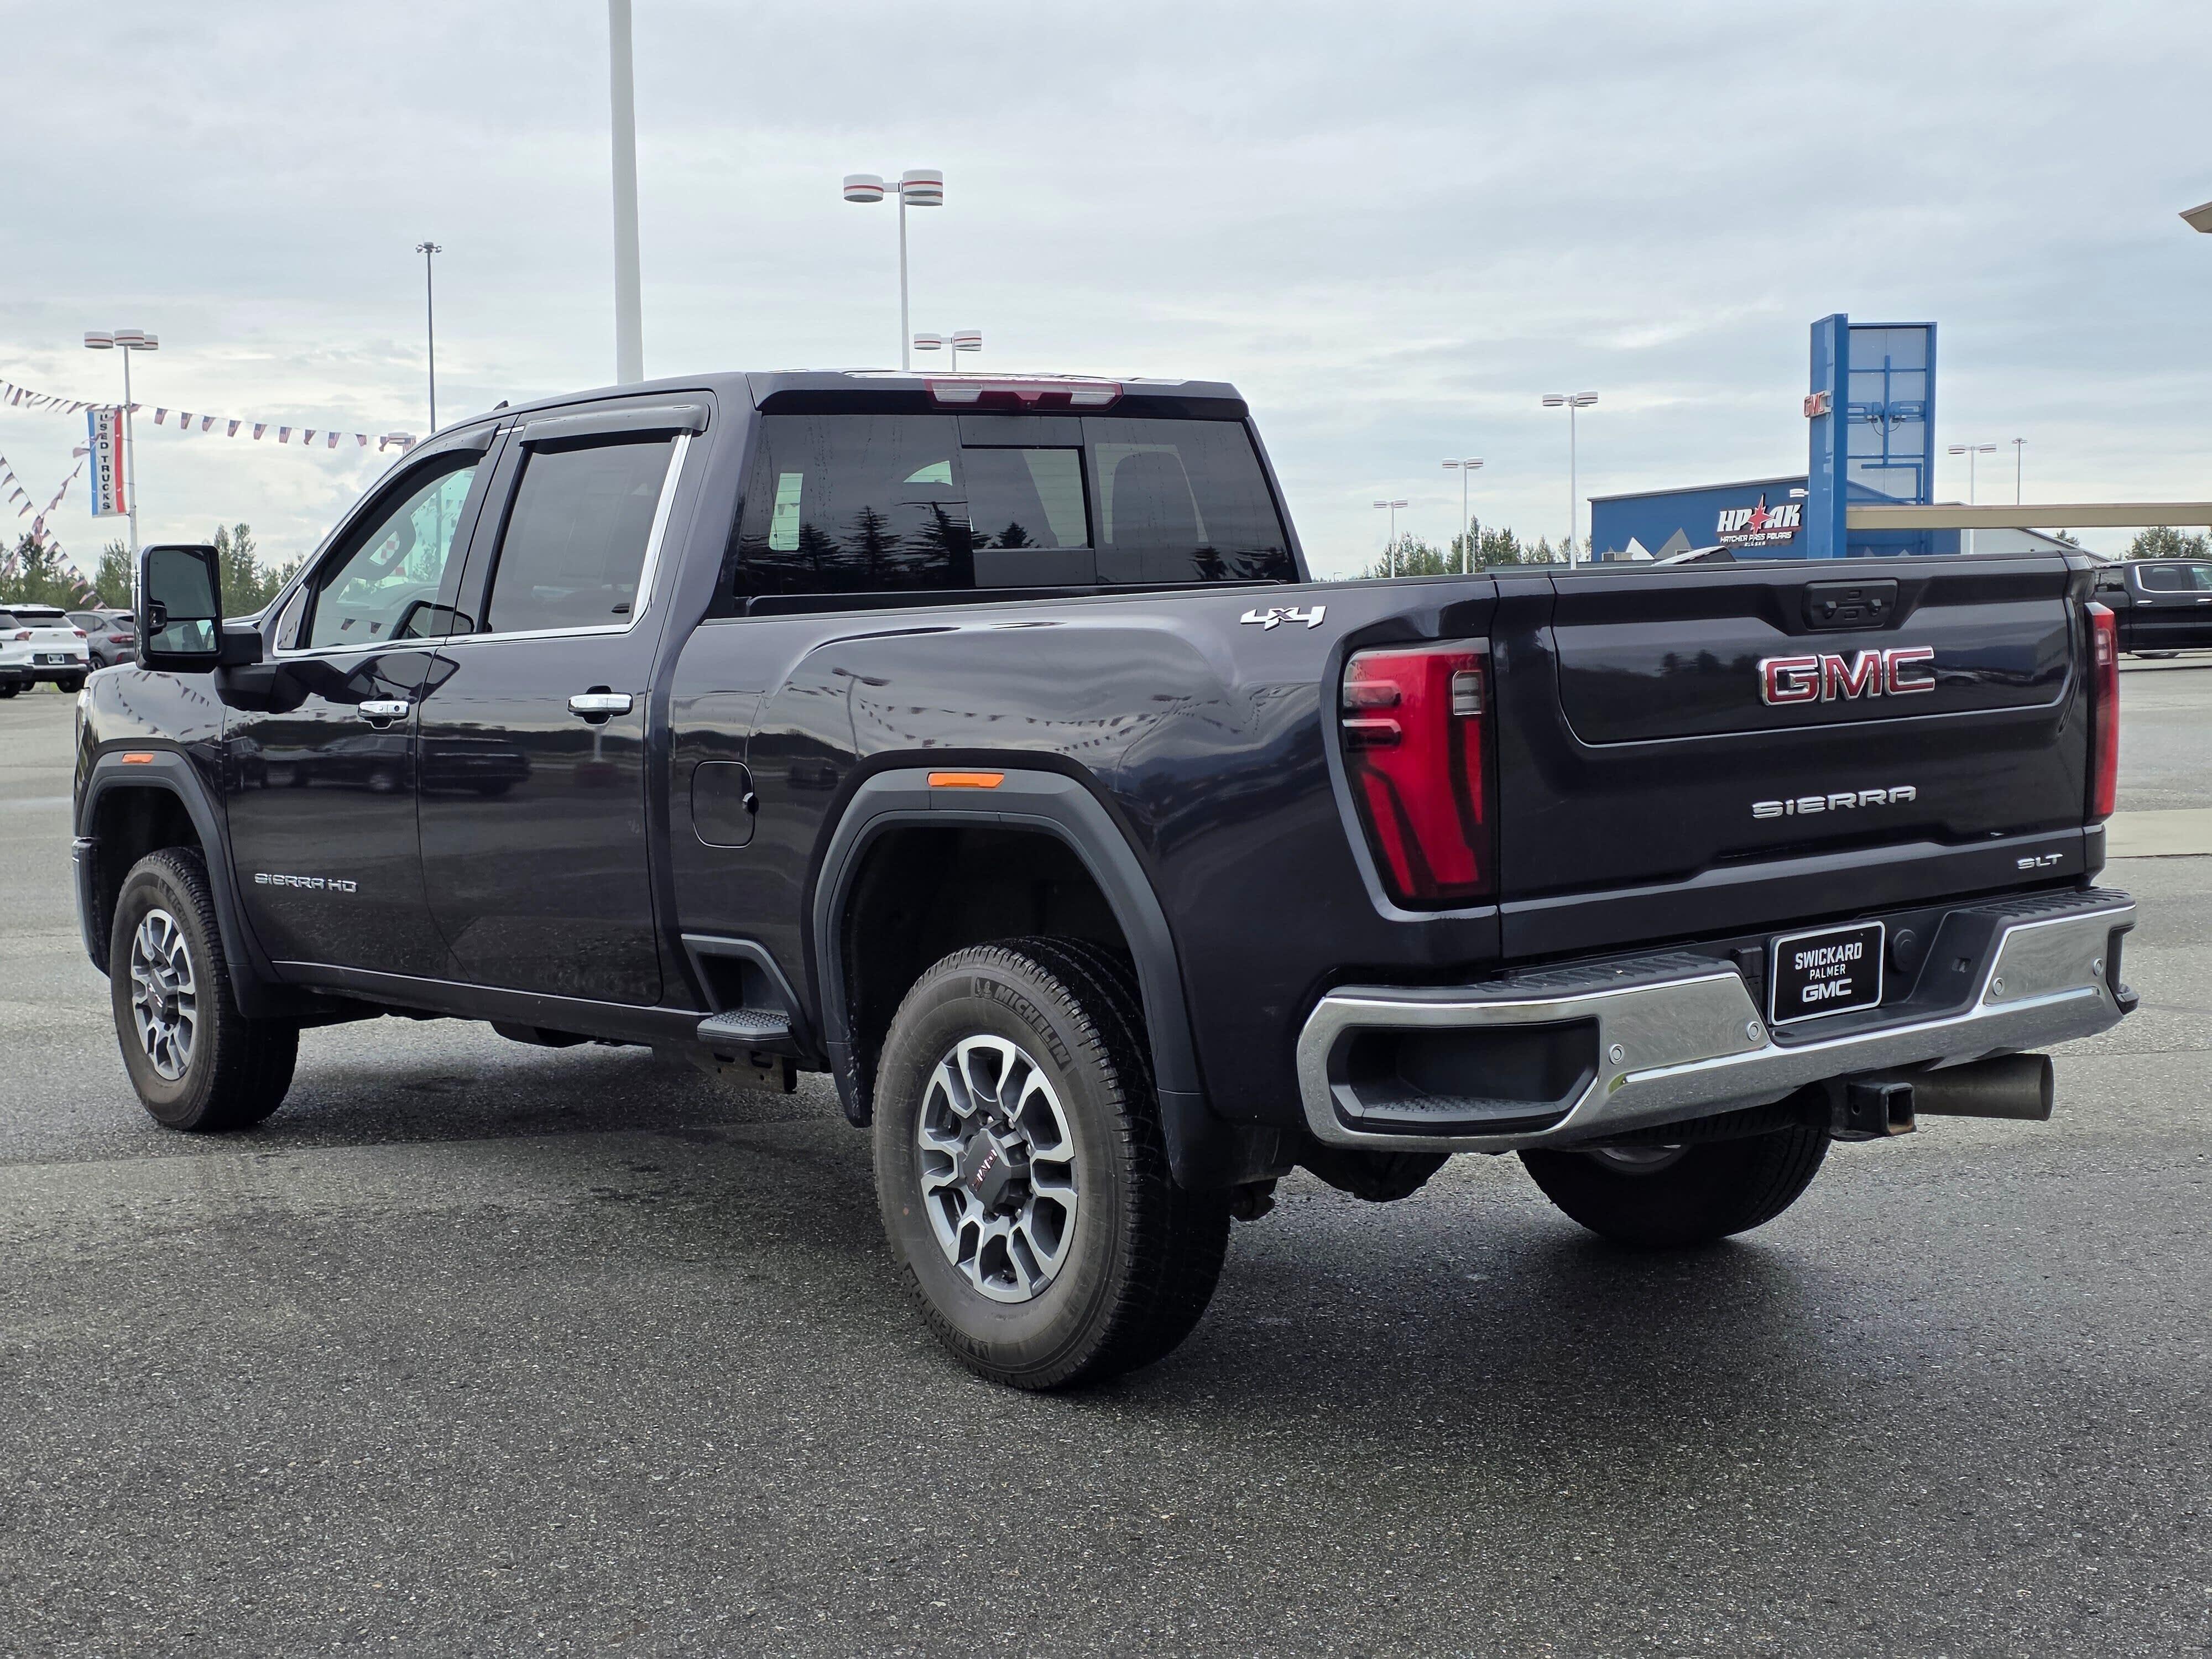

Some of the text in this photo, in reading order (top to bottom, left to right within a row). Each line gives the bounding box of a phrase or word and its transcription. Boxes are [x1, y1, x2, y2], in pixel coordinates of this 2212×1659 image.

[1804, 390, 1832, 418] GMC
[100, 414, 111, 510] USED TRUCKS
[1717, 504, 1801, 532] HP AK
[1749, 533, 1766, 542] PASS
[1766, 531, 1792, 540] POLARIS
[1756, 646, 1935, 706] GMC
[1751, 785, 1916, 819] SIERRA
[2017, 853, 2063, 869] SLT
[254, 873, 357, 893] SIERRA HD
[1795, 942, 1863, 970] SWICKARD
[1809, 964, 1846, 980] PALMER
[1802, 978, 1852, 1003] GMC
[995, 984, 1070, 1065] MICHELIN
